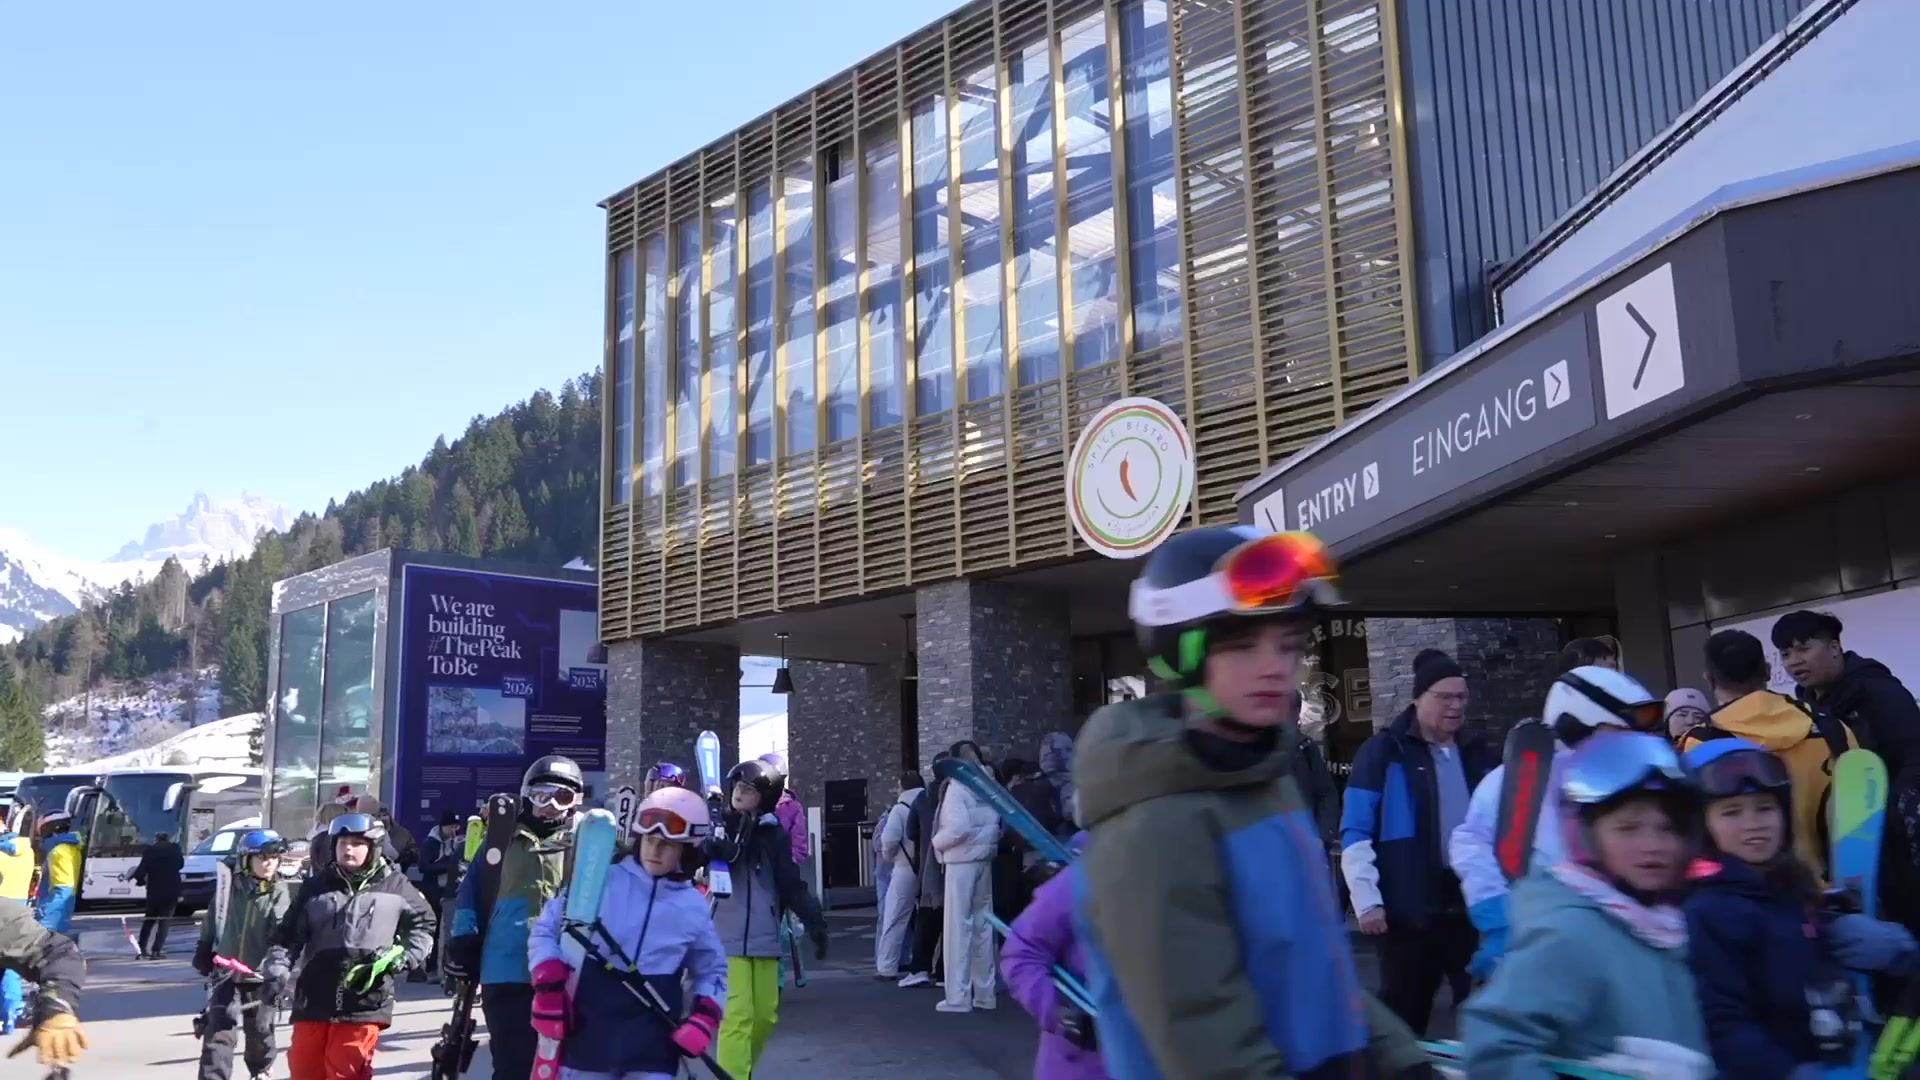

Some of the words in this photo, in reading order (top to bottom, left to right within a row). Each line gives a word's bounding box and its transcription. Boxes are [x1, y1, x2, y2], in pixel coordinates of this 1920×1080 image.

[1413, 378, 1537, 477] EINGANG
[1087, 428, 1117, 469] SPICE
[1126, 421, 1169, 452] BISTRO
[1297, 471, 1357, 532] ENTRY
[430, 593, 463, 615] We
[465, 602, 496, 618] are
[428, 613, 506, 645] building
[1330, 618, 1369, 639] BIS
[428, 635, 523, 661] #ThePeak
[427, 655, 479, 677] ToBe
[503, 682, 534, 696] 2026
[571, 674, 598, 689] 2025
